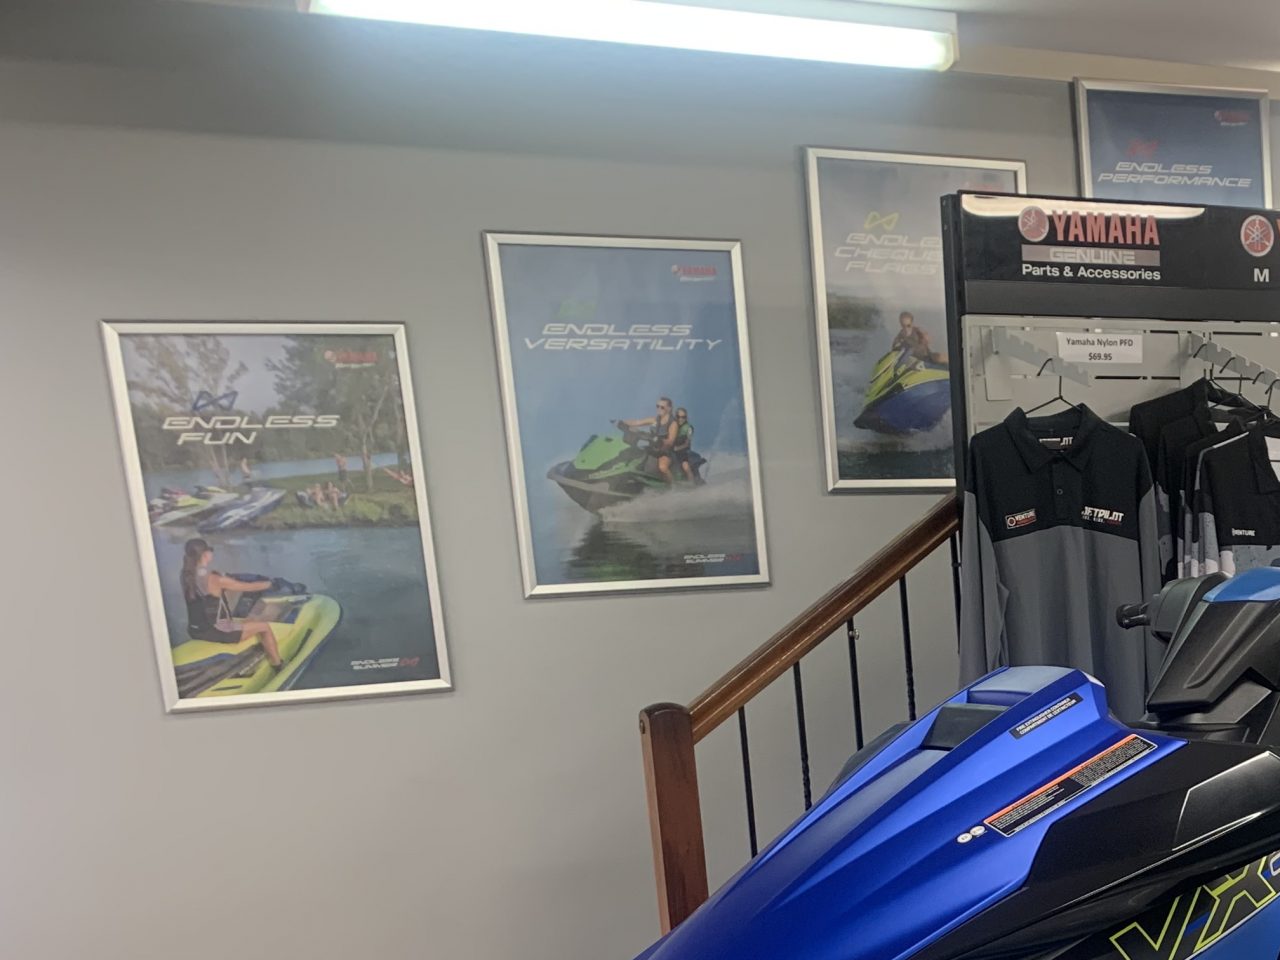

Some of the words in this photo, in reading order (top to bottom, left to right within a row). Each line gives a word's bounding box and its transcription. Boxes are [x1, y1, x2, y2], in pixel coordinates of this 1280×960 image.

[1116, 162, 1213, 174] ENDLESS
[1098, 173, 1252, 187] PERFORMANCE
[1052, 210, 1160, 246] YAMAHA
[1051, 248, 1135, 264] GENUINE
[845, 260, 937, 275] FLAGS
[1022, 264, 1060, 277] Parts
[1063, 265, 1073, 277] &
[1078, 266, 1161, 281] Accessories
[542, 323, 693, 336] ENDLESS
[524, 337, 722, 351] VERSATILITY
[1066, 338, 1095, 347] Yamaha
[1097, 338, 1118, 348] Nylon
[1120, 339, 1134, 347] PFD
[162, 415, 341, 430] ENDLESS
[177, 431, 257, 446] FUN
